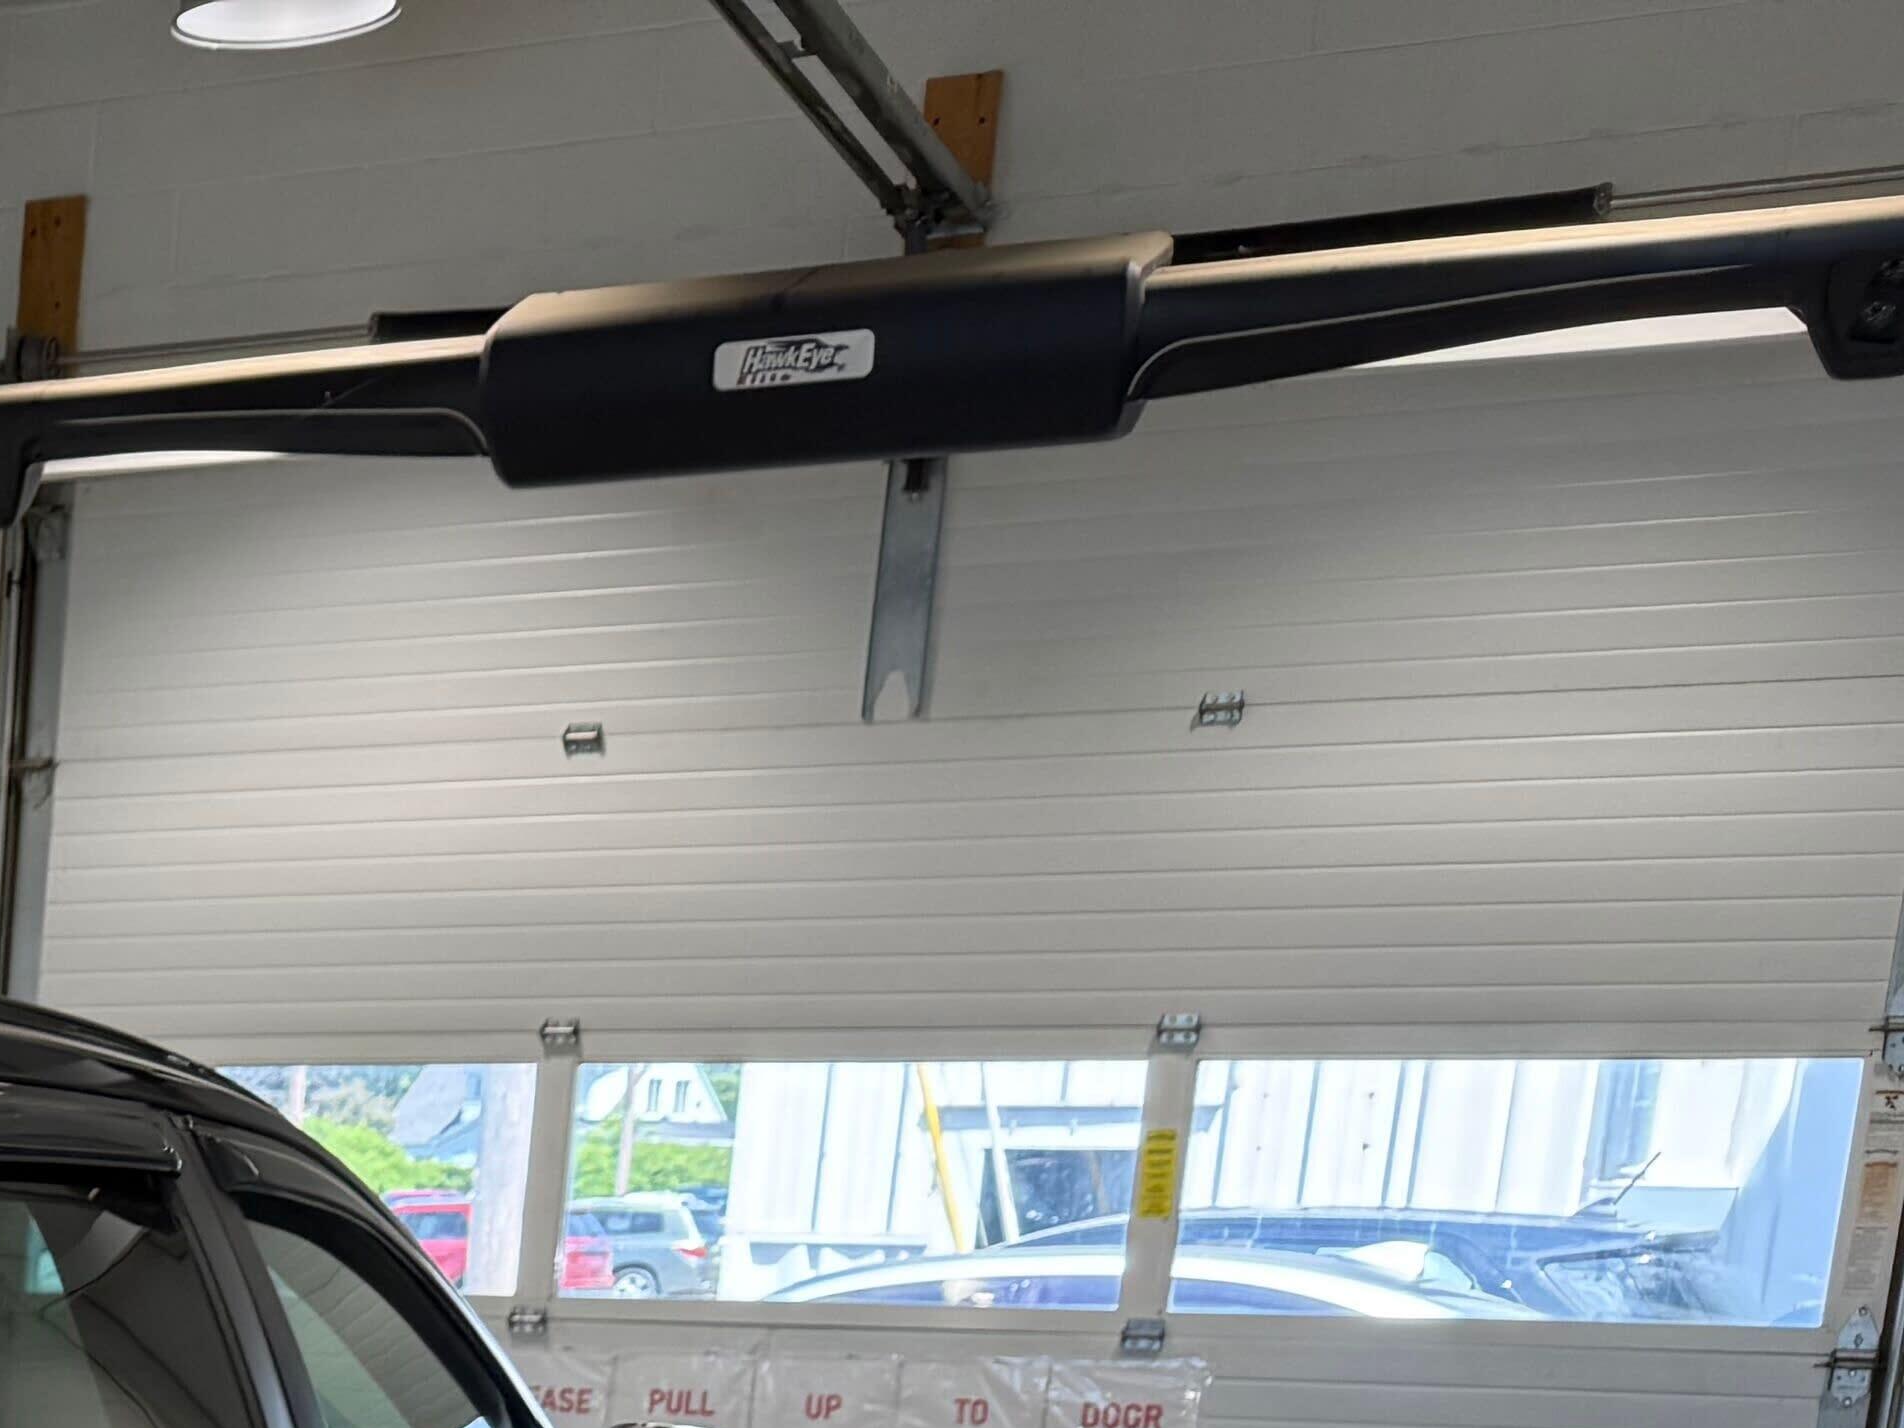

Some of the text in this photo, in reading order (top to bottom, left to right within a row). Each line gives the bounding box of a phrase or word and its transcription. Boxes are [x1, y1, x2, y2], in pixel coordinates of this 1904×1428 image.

[648, 1387, 715, 1417] PULL
[804, 1393, 843, 1421] UP
[954, 1398, 989, 1426] TO
